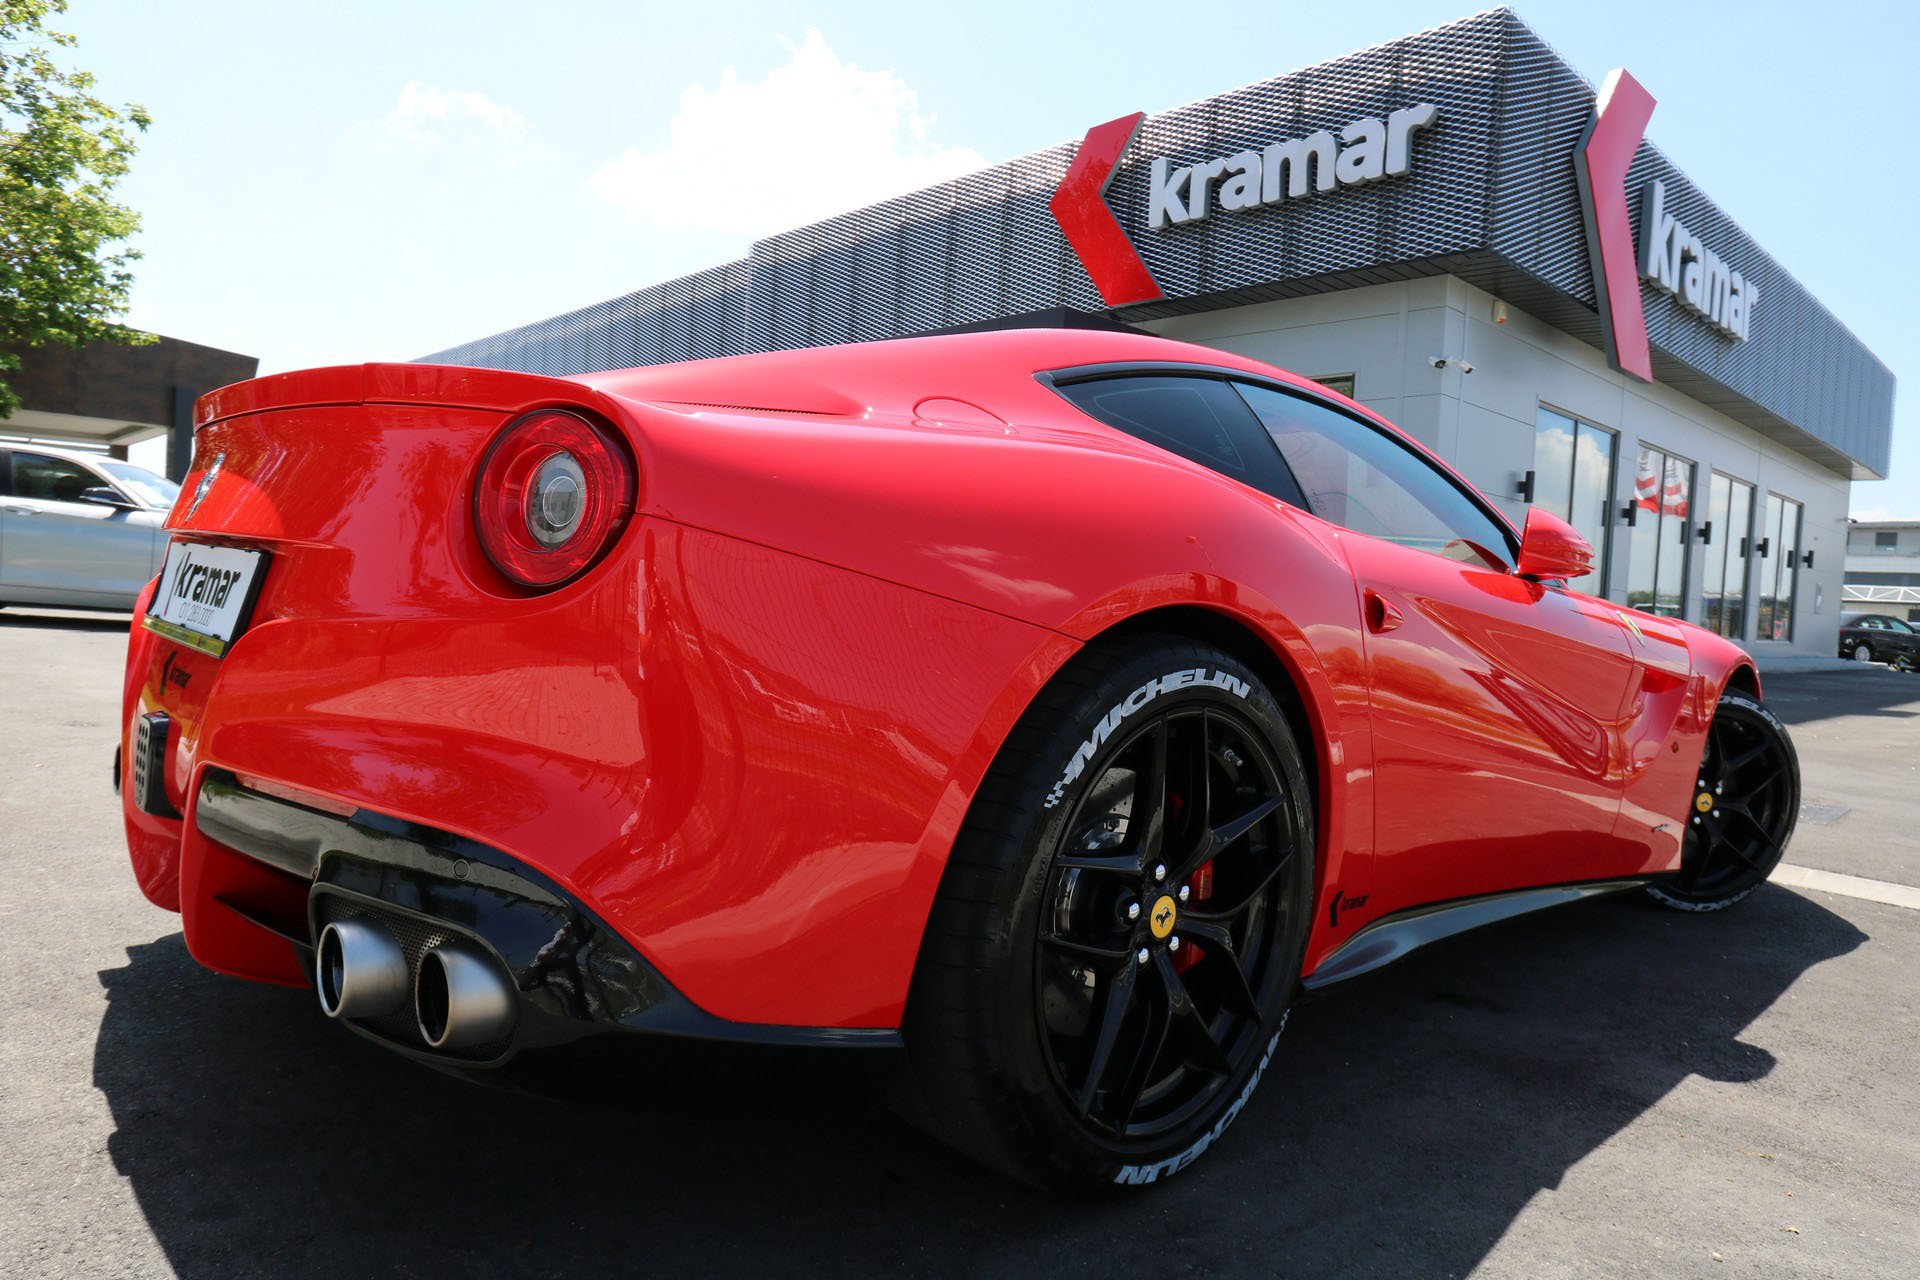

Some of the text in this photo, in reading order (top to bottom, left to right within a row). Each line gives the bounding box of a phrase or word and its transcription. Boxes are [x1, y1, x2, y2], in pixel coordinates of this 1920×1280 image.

[1149, 103, 1440, 231] kramar
[1640, 180, 1760, 344] kramar
[173, 552, 241, 609] kramar
[1060, 668, 1250, 784] MICHELIN
